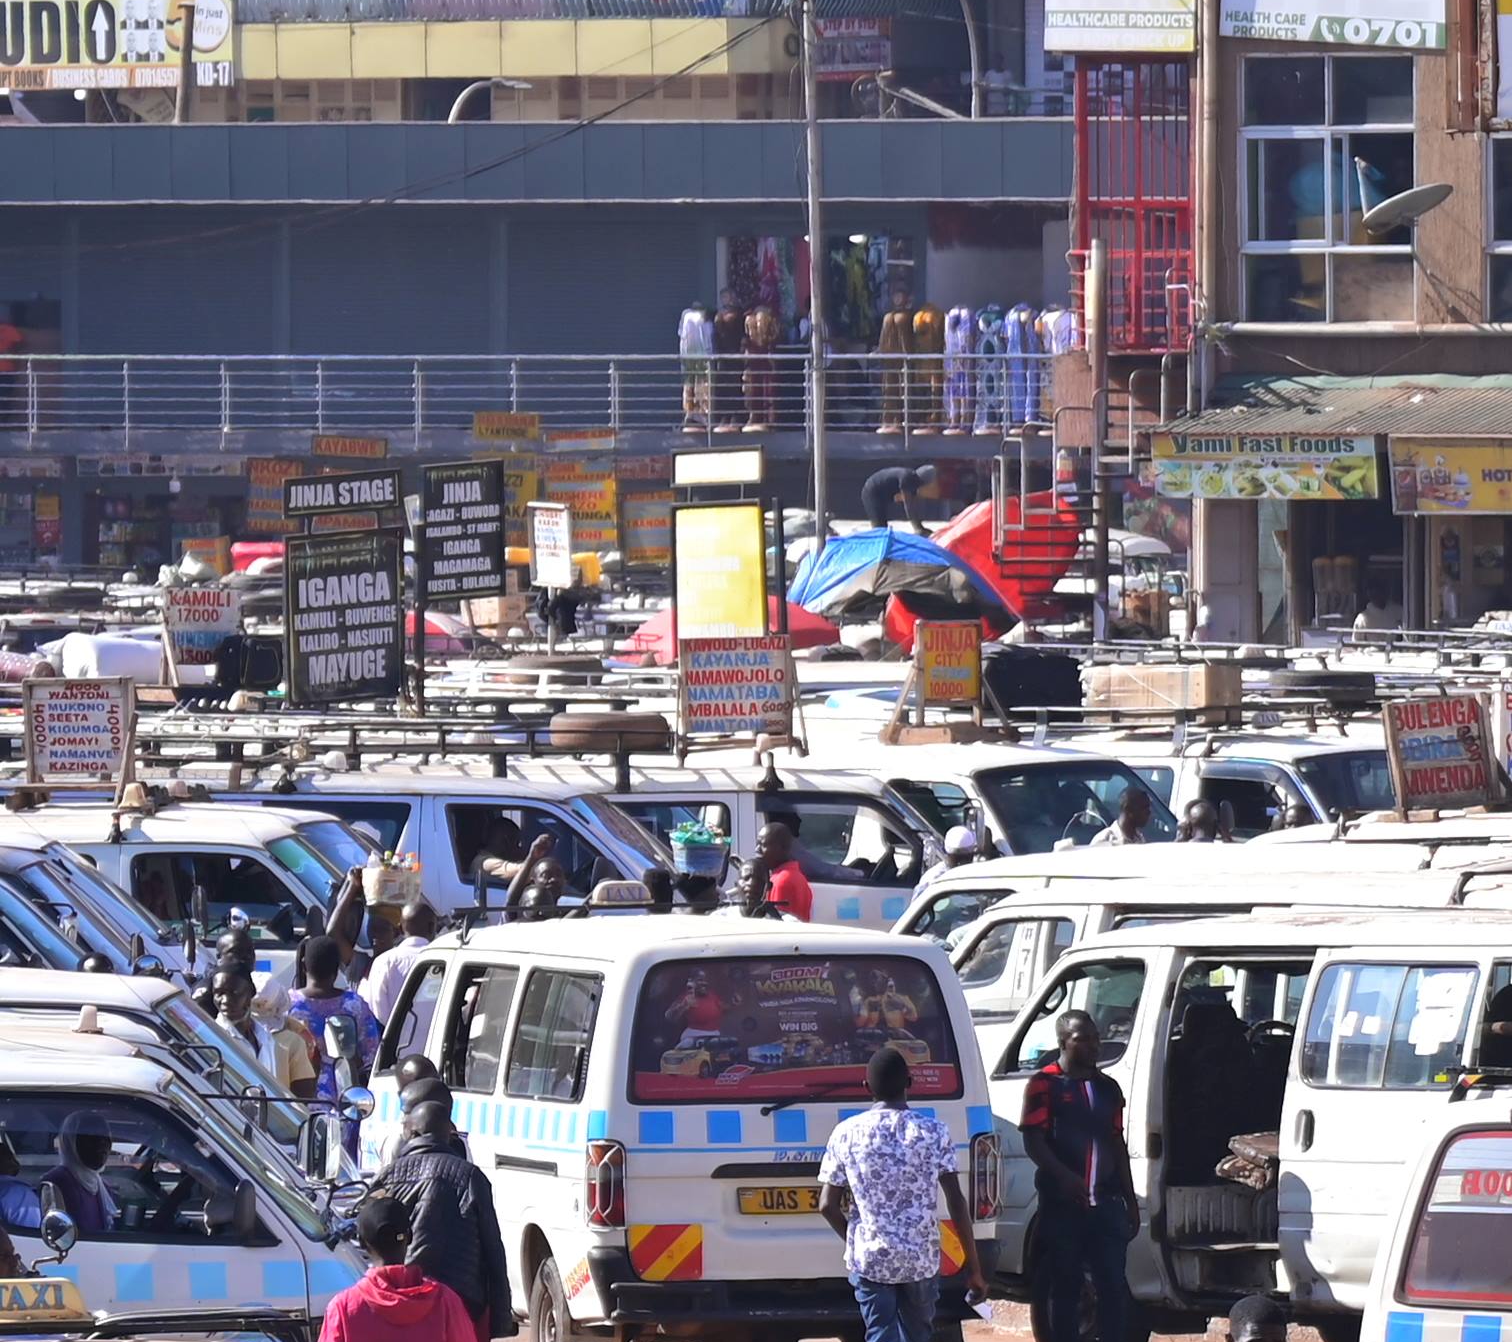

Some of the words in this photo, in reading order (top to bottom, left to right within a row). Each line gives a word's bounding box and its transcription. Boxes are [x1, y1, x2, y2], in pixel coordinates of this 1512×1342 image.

[1048, 12, 1127, 27] HEALTHCARE
[1130, 12, 1193, 28] PRODUCTS
[1225, 10, 1272, 25] HEALTH
[1275, 12, 1307, 26] CARE
[1343, 19, 1440, 48] 0701
[1233, 25, 1298, 40] PRODUCTS
[1237, 435, 1286, 453] Fast
[1290, 435, 1356, 453] Foods
[289, 482, 336, 508] JINJA
[338, 478, 394, 506] STAGE
[442, 481, 482, 505] JINJA
[443, 539, 480, 555] IGANGA
[434, 557, 491, 575] MAGAMAGA
[299, 572, 391, 608] IGANGA
[308, 649, 387, 686] MAYUGE
[691, 653, 770, 667] KAYANJA
[686, 668, 784, 685] NAMAWOJOLO
[688, 685, 780, 701] NAMATABA
[48, 703, 105, 712] MUKONO
